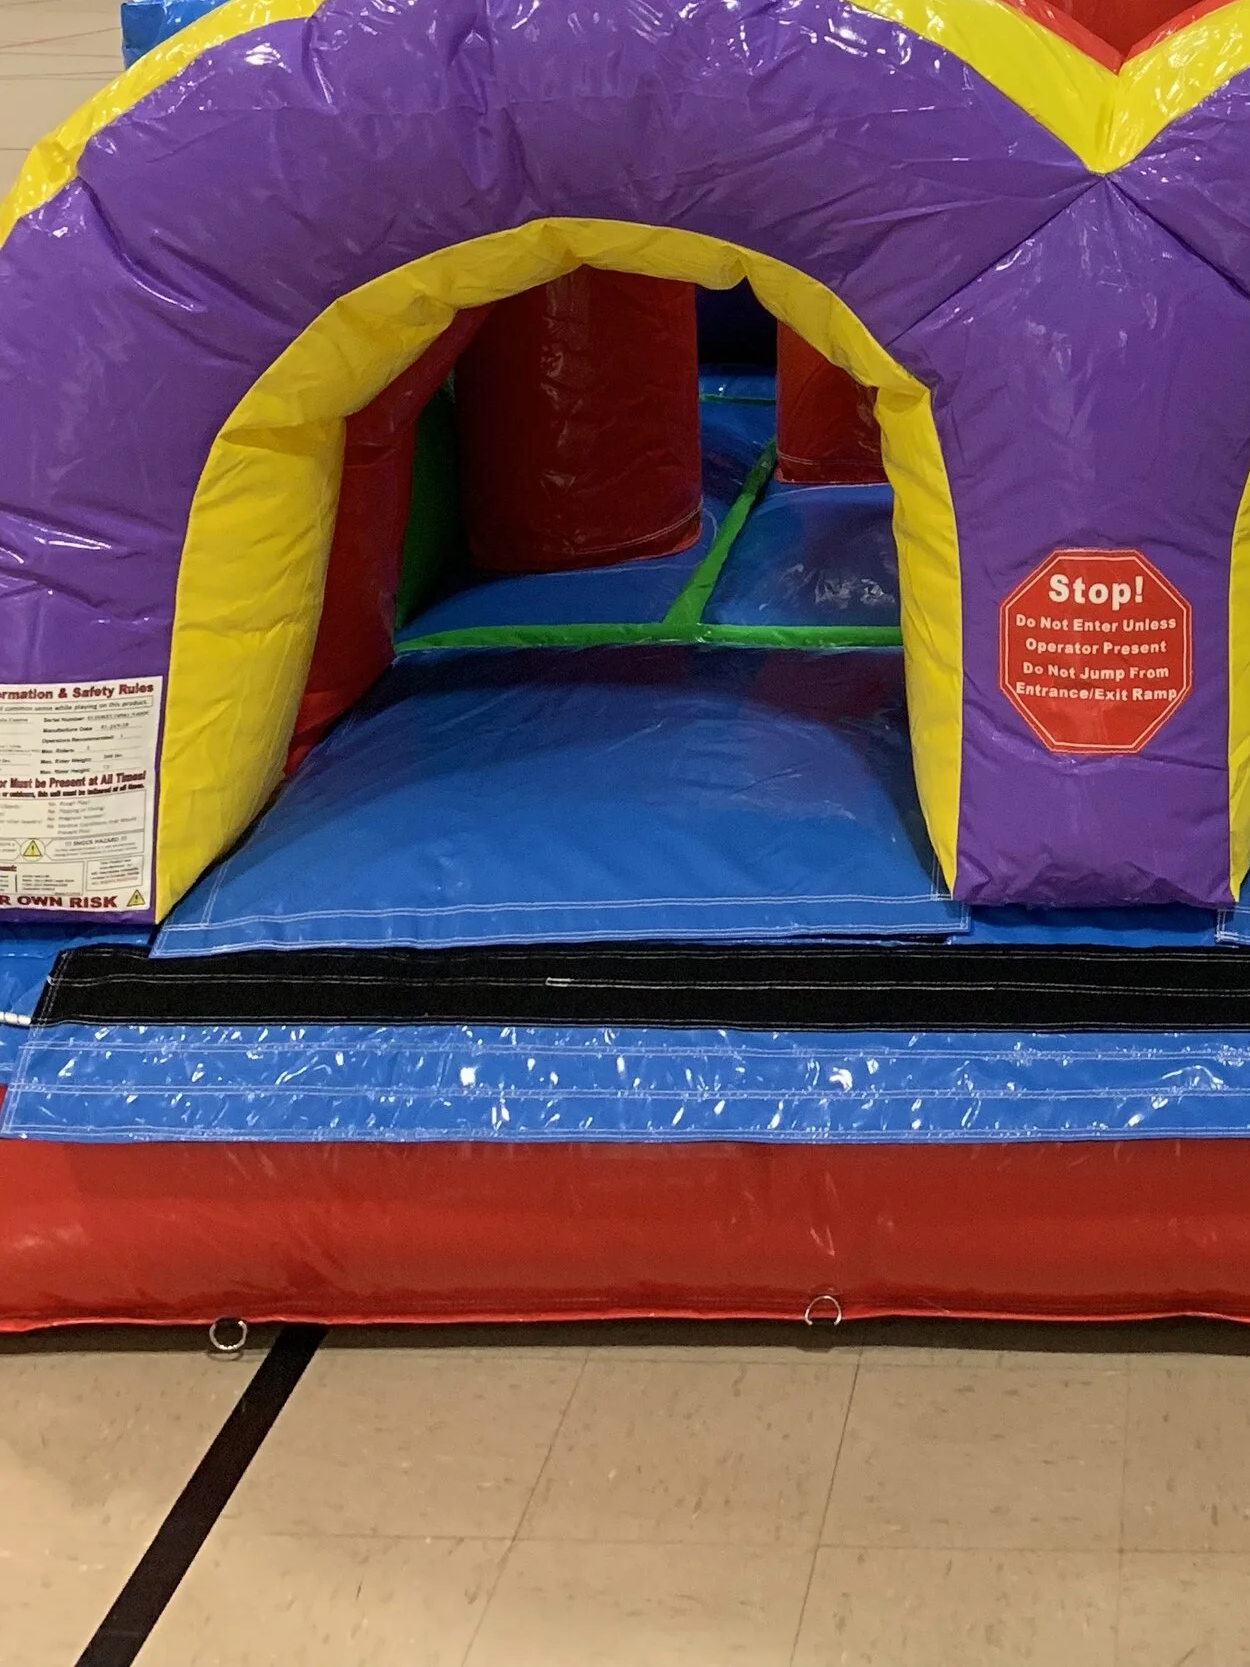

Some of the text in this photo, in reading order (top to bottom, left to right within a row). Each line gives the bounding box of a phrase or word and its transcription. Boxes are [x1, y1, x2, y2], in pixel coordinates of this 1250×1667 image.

[1048, 573, 1144, 611] Stop!
[1015, 614, 1177, 632] Do Not Enter Unless
[1025, 638, 1167, 655] Operator Present
[1023, 662, 1169, 682] Do Not Jump From
[0, 682, 154, 700] rmation & Safety Rules
[1016, 682, 1178, 702] Entrance/Exit Ramp
[35, 777, 46, 788] be
[49, 776, 85, 788] Present
[89, 776, 98, 786] at
[101, 774, 113, 785] All
[116, 770, 146, 783] Times!
[17, 896, 63, 907] OWN
[69, 896, 118, 908] RISK
